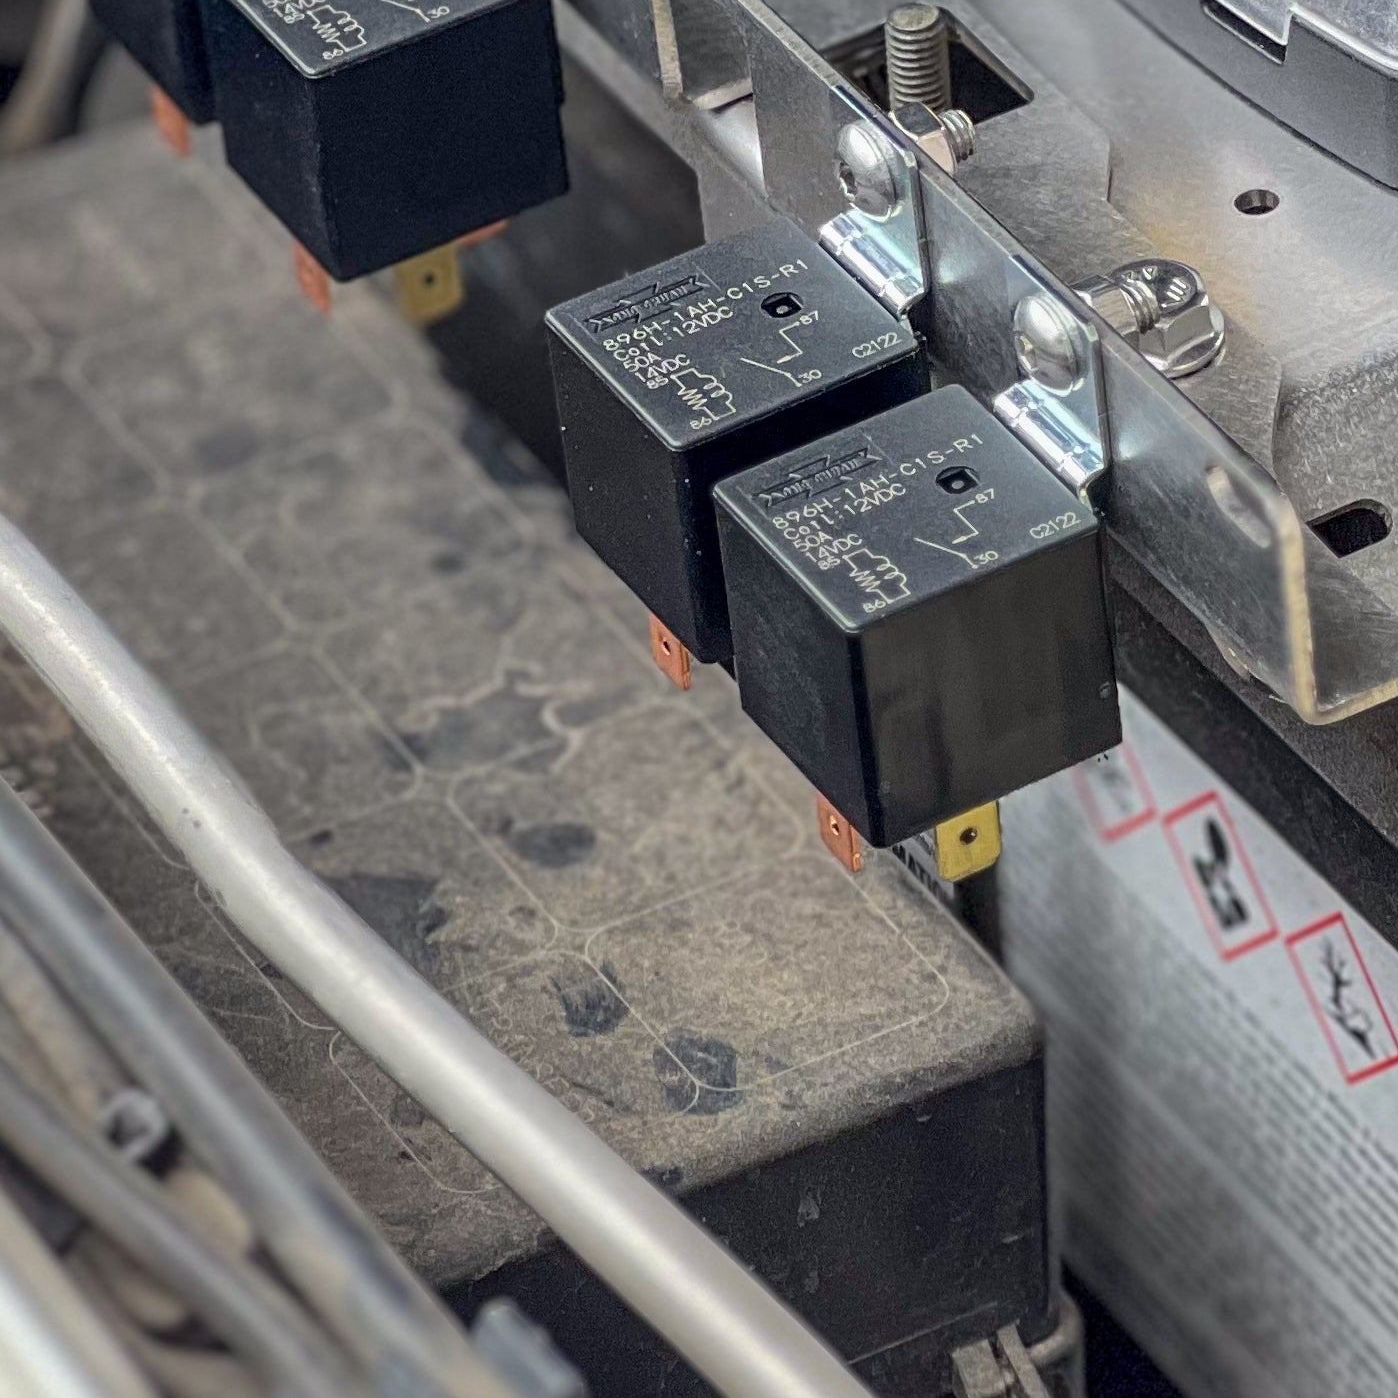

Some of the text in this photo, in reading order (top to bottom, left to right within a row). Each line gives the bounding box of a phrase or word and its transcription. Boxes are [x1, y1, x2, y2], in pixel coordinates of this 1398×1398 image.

[603, 260, 808, 351] 896H-1AH-C1S-R1
[800, 310, 819, 325] 87
[852, 332, 903, 359] C2122
[623, 352, 662, 373] 50A
[635, 354, 690, 382] 14VDC
[647, 376, 669, 389] 85
[801, 369, 822, 383] 30
[690, 416, 712, 429] 86
[773, 433, 983, 530] 896H-1AH-C1S-R1
[975, 488, 995, 504] 87
[1029, 511, 1081, 539] C2122
[793, 531, 833, 553] 50A
[806, 533, 863, 562] 14VDC
[818, 555, 840, 570] 85
[976, 550, 999, 564] 30
[863, 599, 887, 613] 86
